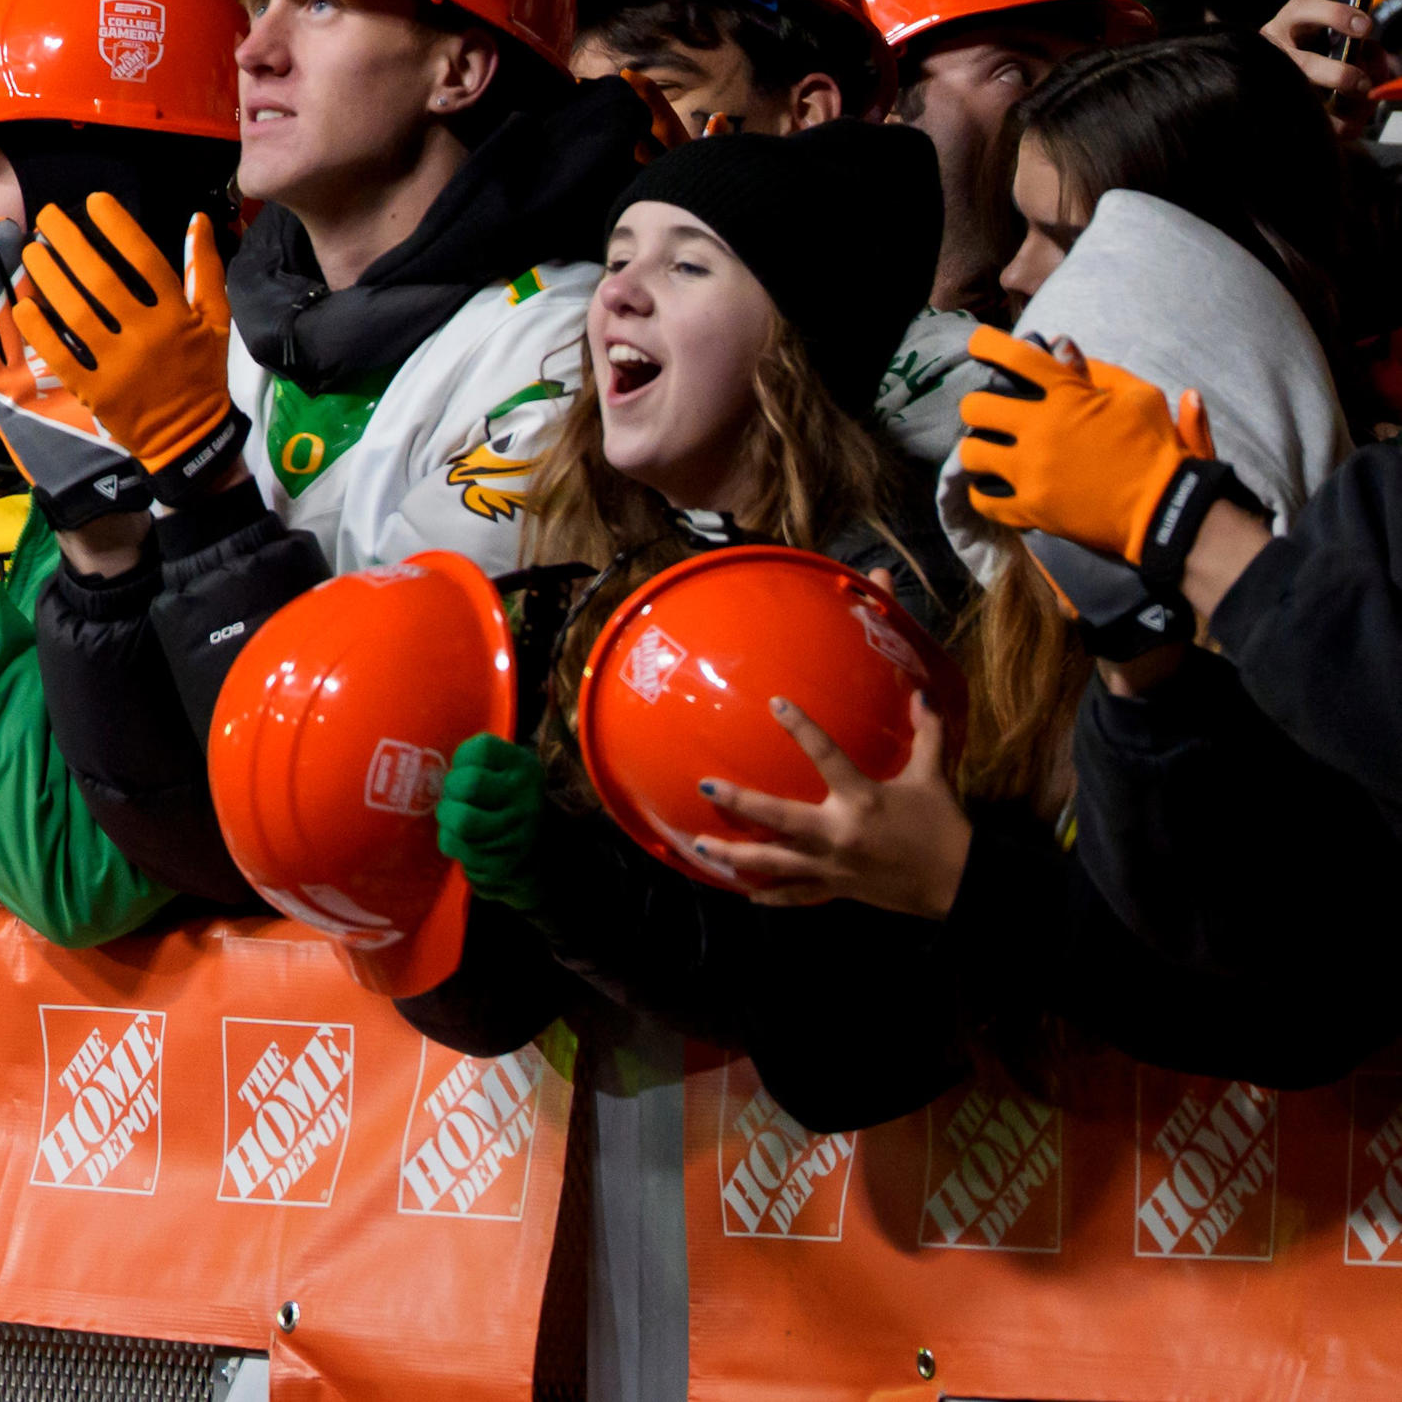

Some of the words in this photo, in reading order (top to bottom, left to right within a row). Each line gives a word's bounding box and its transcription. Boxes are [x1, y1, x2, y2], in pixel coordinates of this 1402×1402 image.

[99, 27, 164, 43] GAMEDAY
[108, 18, 157, 31] COLLEGE
[114, 3, 151, 16] ESPN
[281, 432, 326, 474] O
[38, 1013, 162, 1184] HOME
[58, 1027, 109, 1098] THE
[237, 1041, 290, 1112] THE
[424, 1054, 481, 1123] THE
[84, 1081, 160, 1187] DEPOT
[223, 1023, 352, 1198] HOME
[267, 1093, 351, 1200] DEPOT
[448, 1105, 534, 1214] DEPOT
[769, 1132, 854, 1235] DEPOT
[1191, 1139, 1274, 1256] DEPOT
